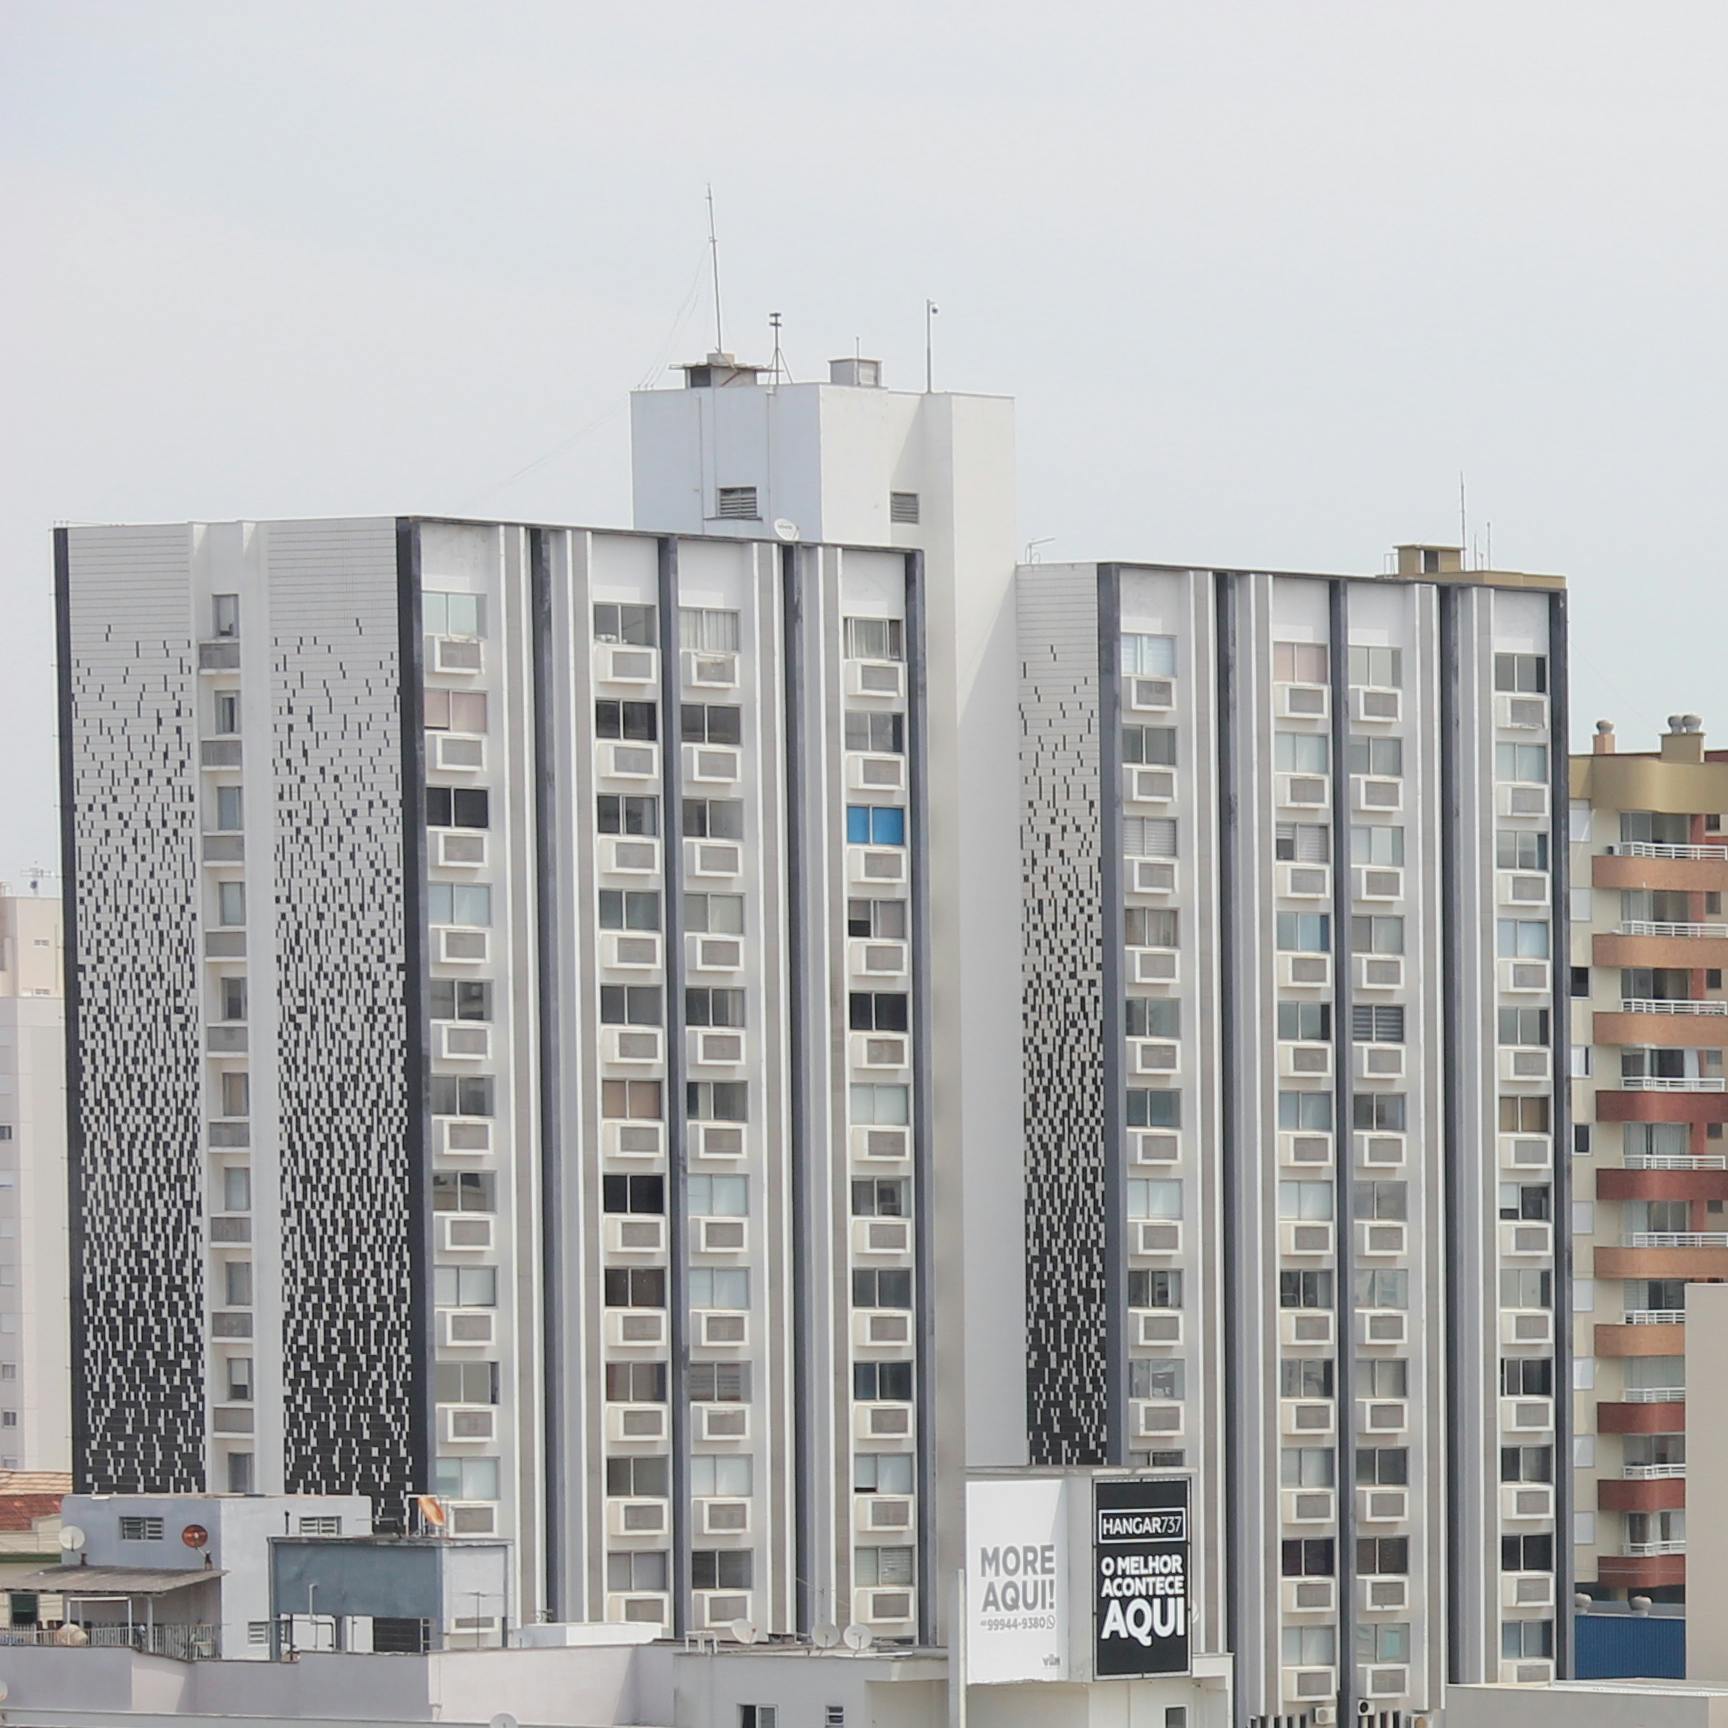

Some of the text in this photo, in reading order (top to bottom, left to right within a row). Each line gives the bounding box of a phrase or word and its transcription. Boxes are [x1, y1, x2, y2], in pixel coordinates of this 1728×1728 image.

[1102, 1516, 1182, 1535] HANGAR737
[980, 1544, 1055, 1578] MORE
[1101, 1554, 1183, 1576] O MELHOR
[981, 1579, 1055, 1612] AQUI!
[1101, 1576, 1185, 1597] ACONTECE
[1101, 1597, 1185, 1647] AQUI
